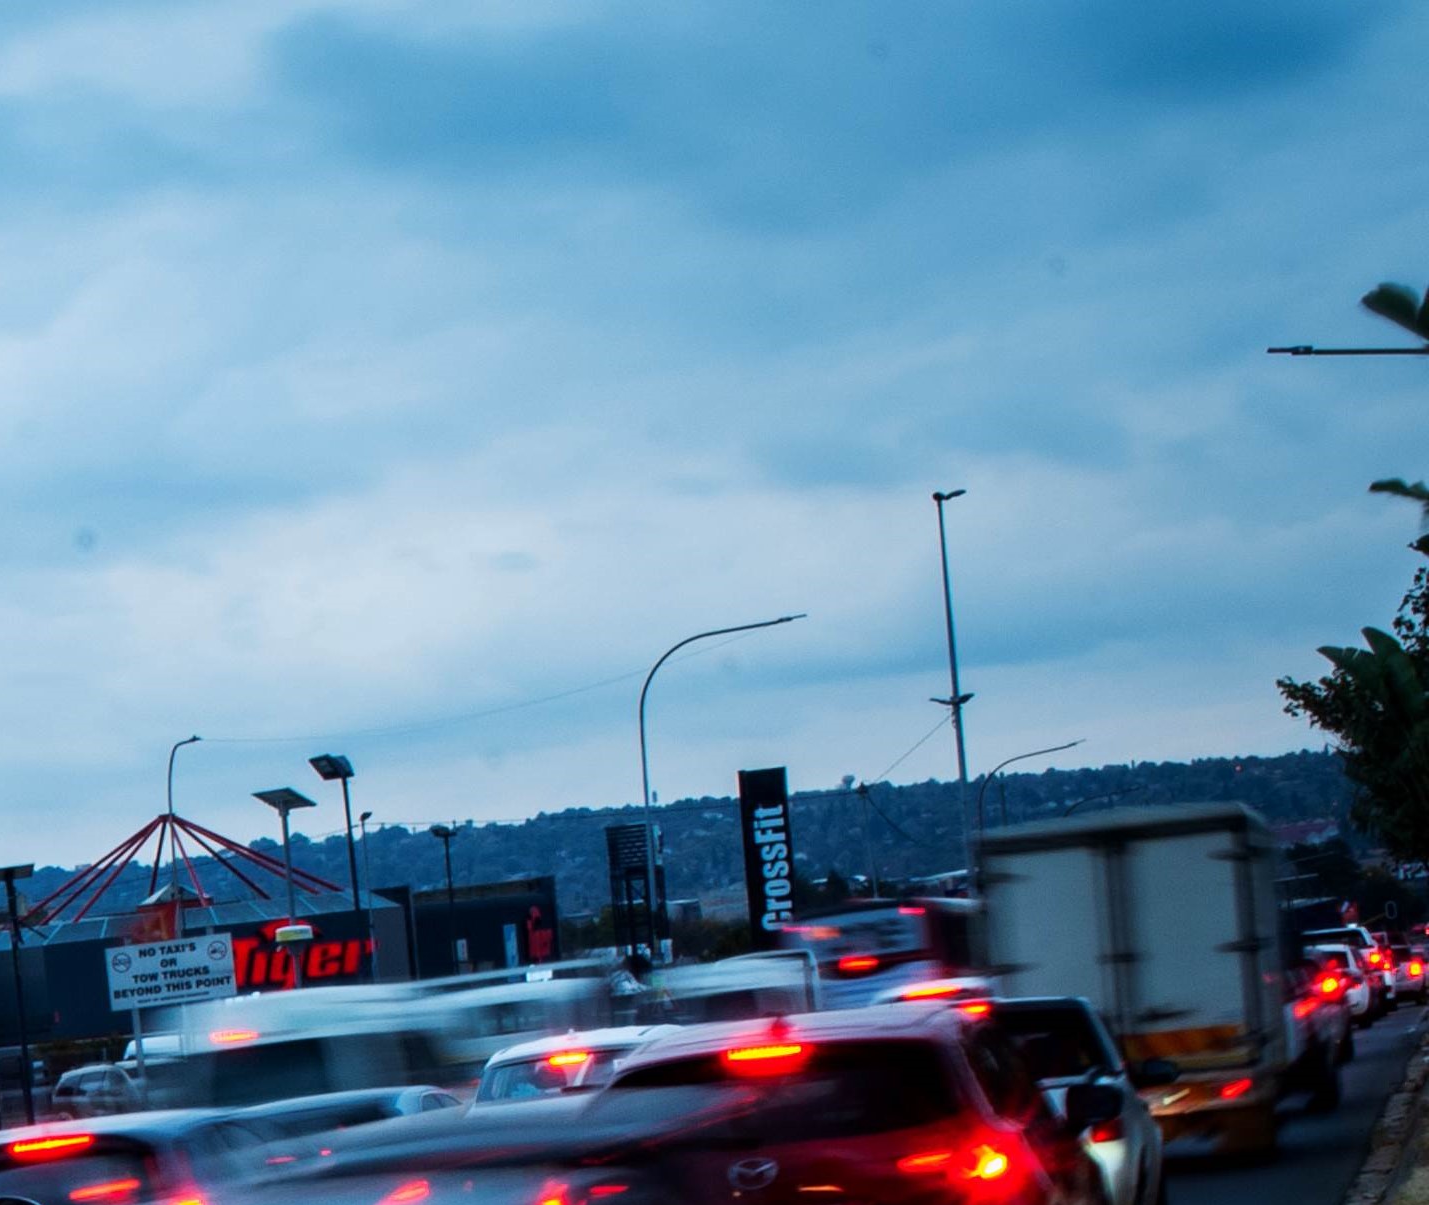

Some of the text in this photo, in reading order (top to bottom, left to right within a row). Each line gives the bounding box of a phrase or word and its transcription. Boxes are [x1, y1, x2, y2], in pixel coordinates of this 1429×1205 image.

[753, 804, 793, 932] CrossFit
[138, 947, 156, 958] NO
[160, 958, 177, 968] OR
[133, 965, 210, 983] TOW TRUCKS
[113, 985, 162, 999] BEYOND
[165, 981, 193, 992] THIS
[195, 975, 232, 989] POINT
